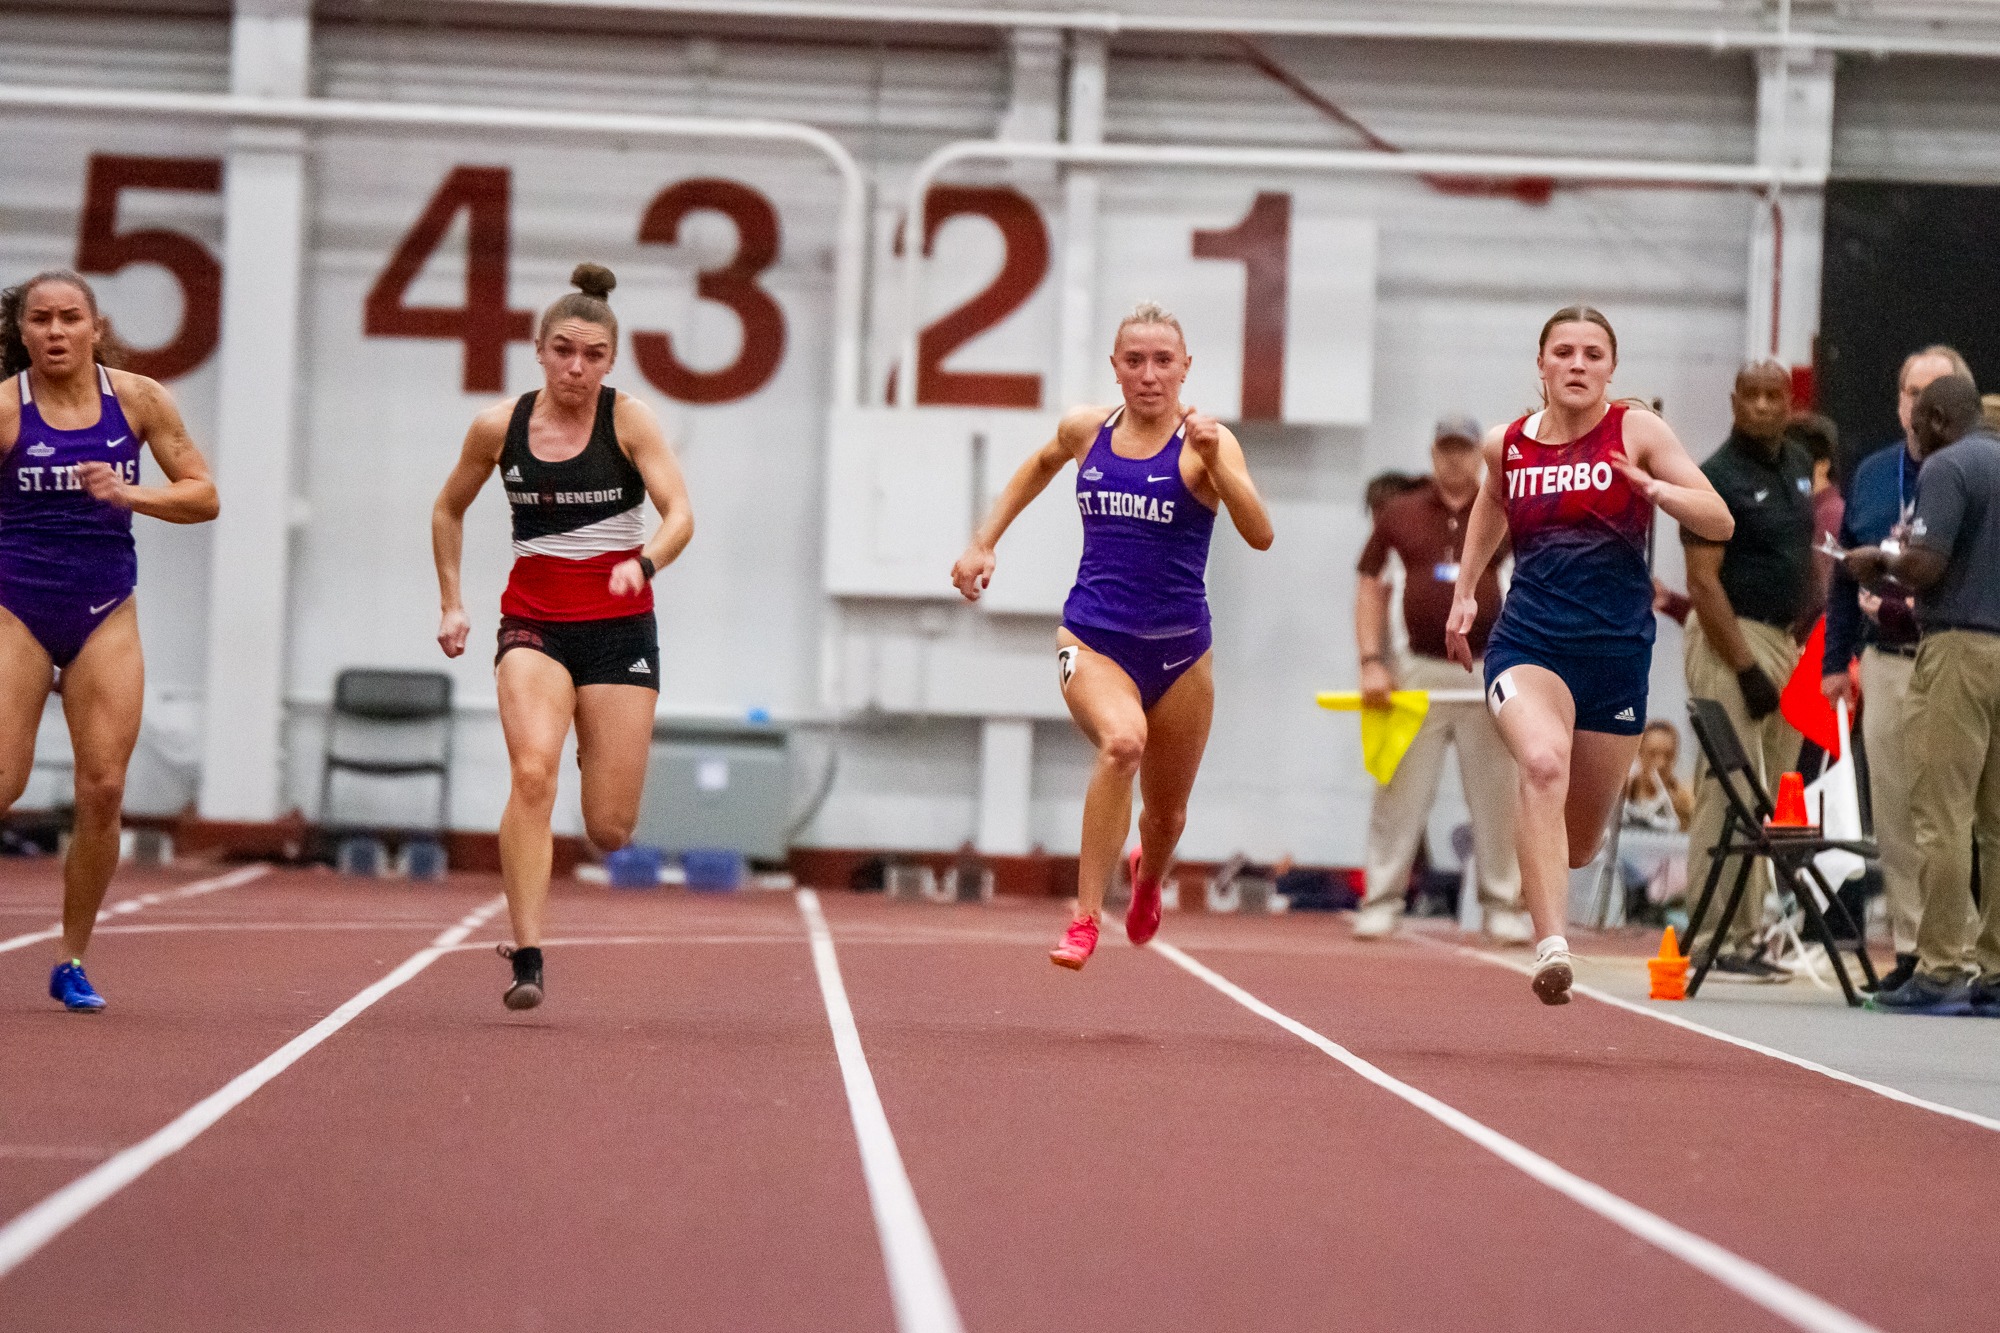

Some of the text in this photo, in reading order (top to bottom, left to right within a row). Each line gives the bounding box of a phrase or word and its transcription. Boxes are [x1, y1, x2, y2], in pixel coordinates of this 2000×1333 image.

[75, 152, 224, 384] 5
[364, 164, 534, 394] 4
[630, 177, 789, 407] 3
[886, 181, 1052, 410] 2
[1191, 190, 1294, 422] 1
[555, 487, 623, 504] BENEDICT
[1505, 461, 1613, 499] VITERBO
[1491, 680, 1506, 704] 1
